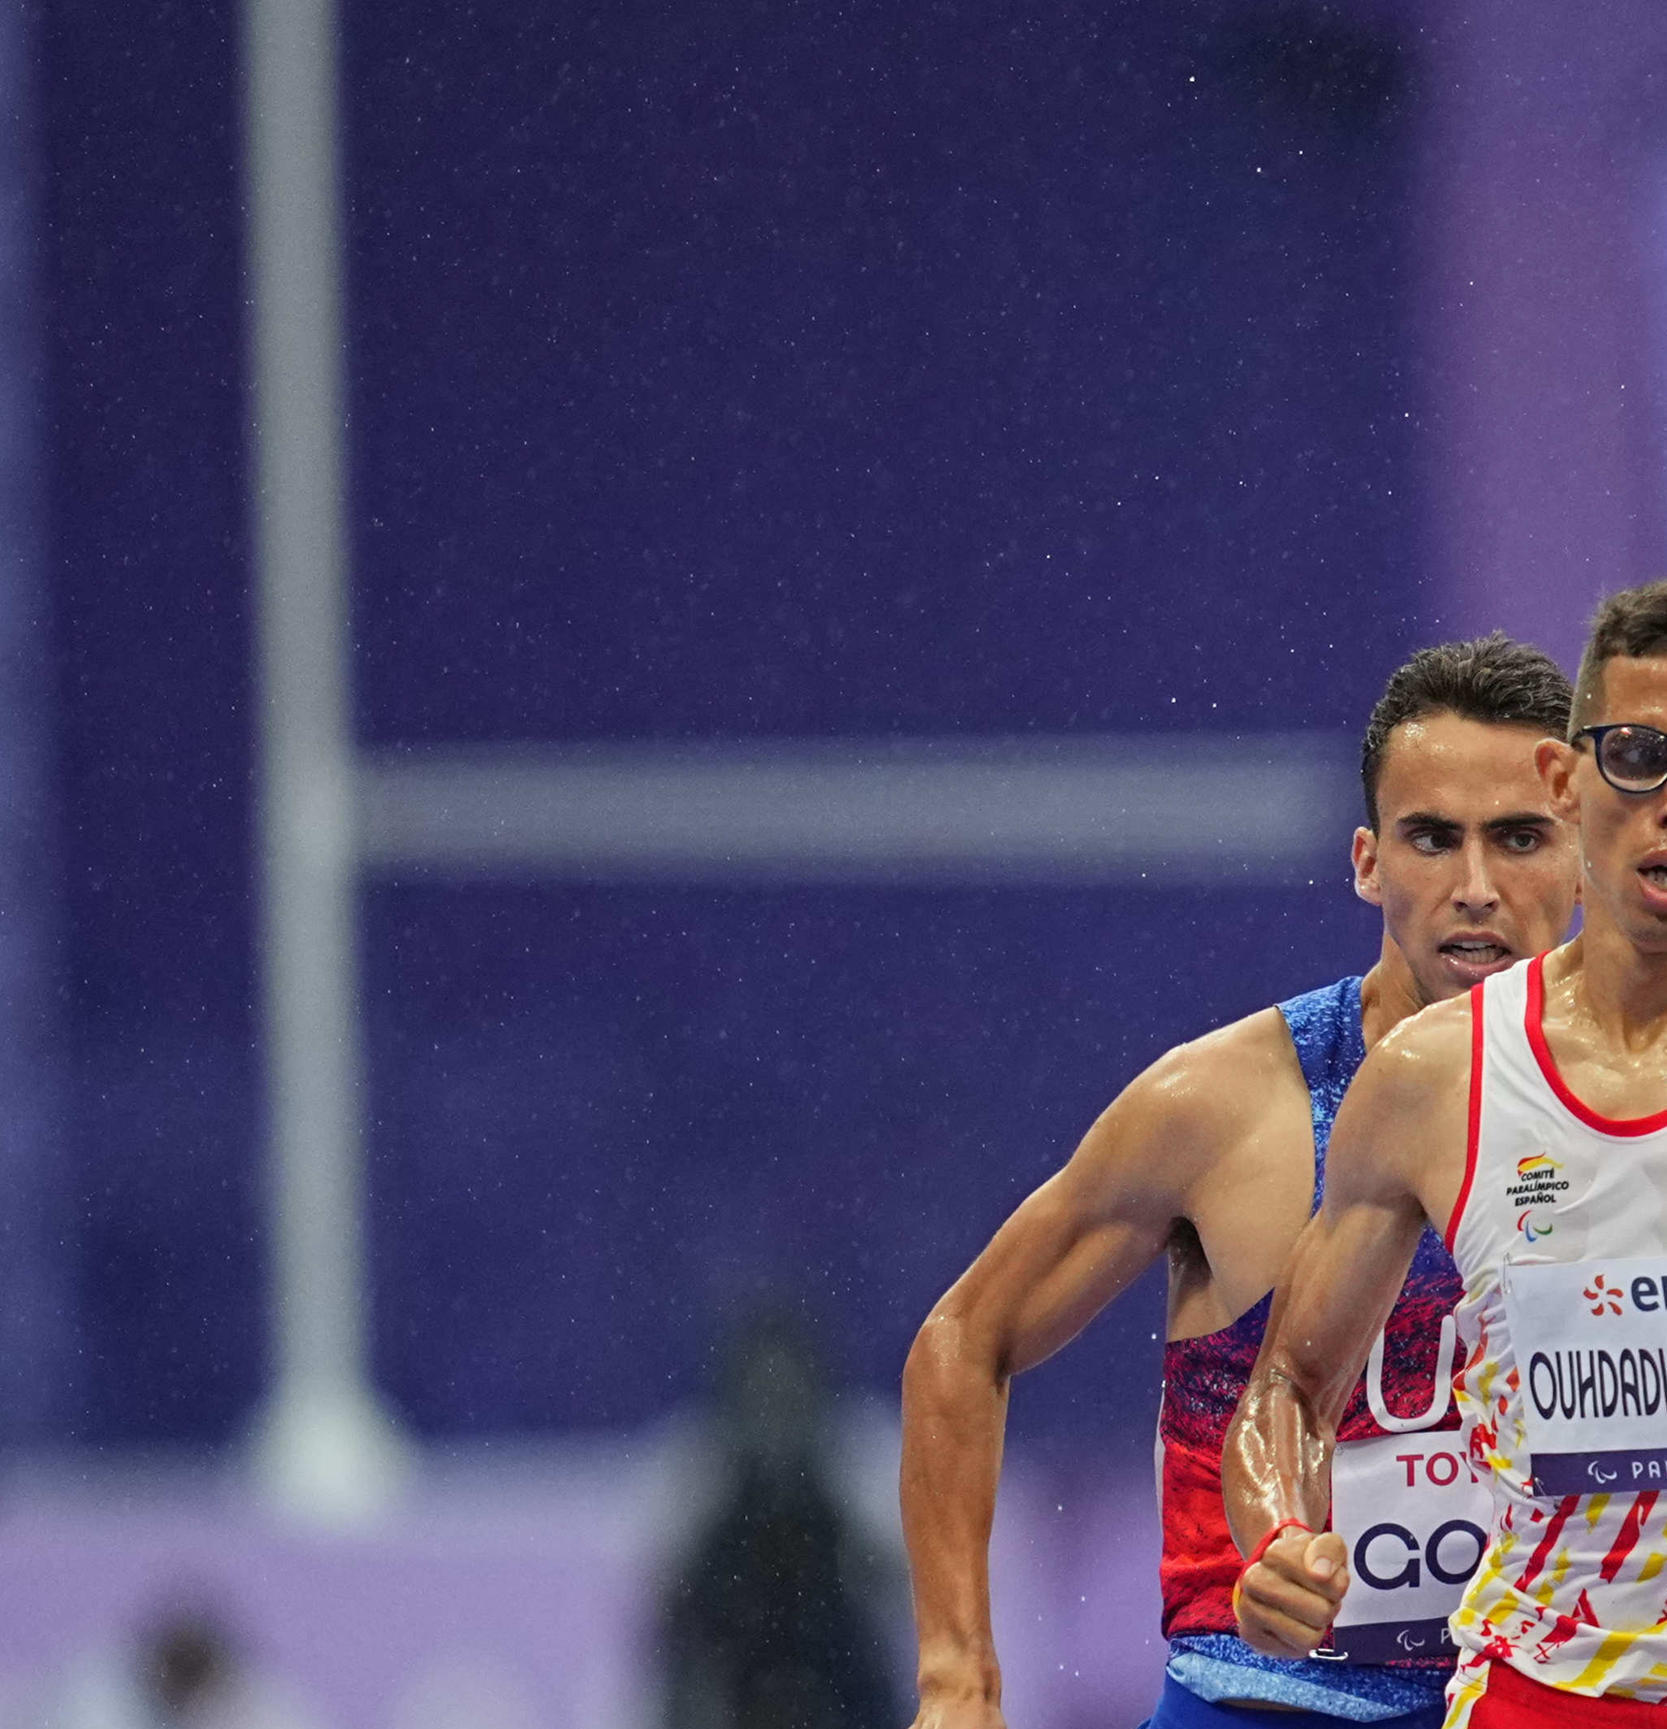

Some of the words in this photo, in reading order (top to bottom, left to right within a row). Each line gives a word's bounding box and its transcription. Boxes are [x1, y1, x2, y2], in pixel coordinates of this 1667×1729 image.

[1521, 1168, 1555, 1182] COMITÉ
[1506, 1180, 1569, 1196] PARALÍMPICO
[1514, 1192, 1557, 1207] ESPAÑOL
